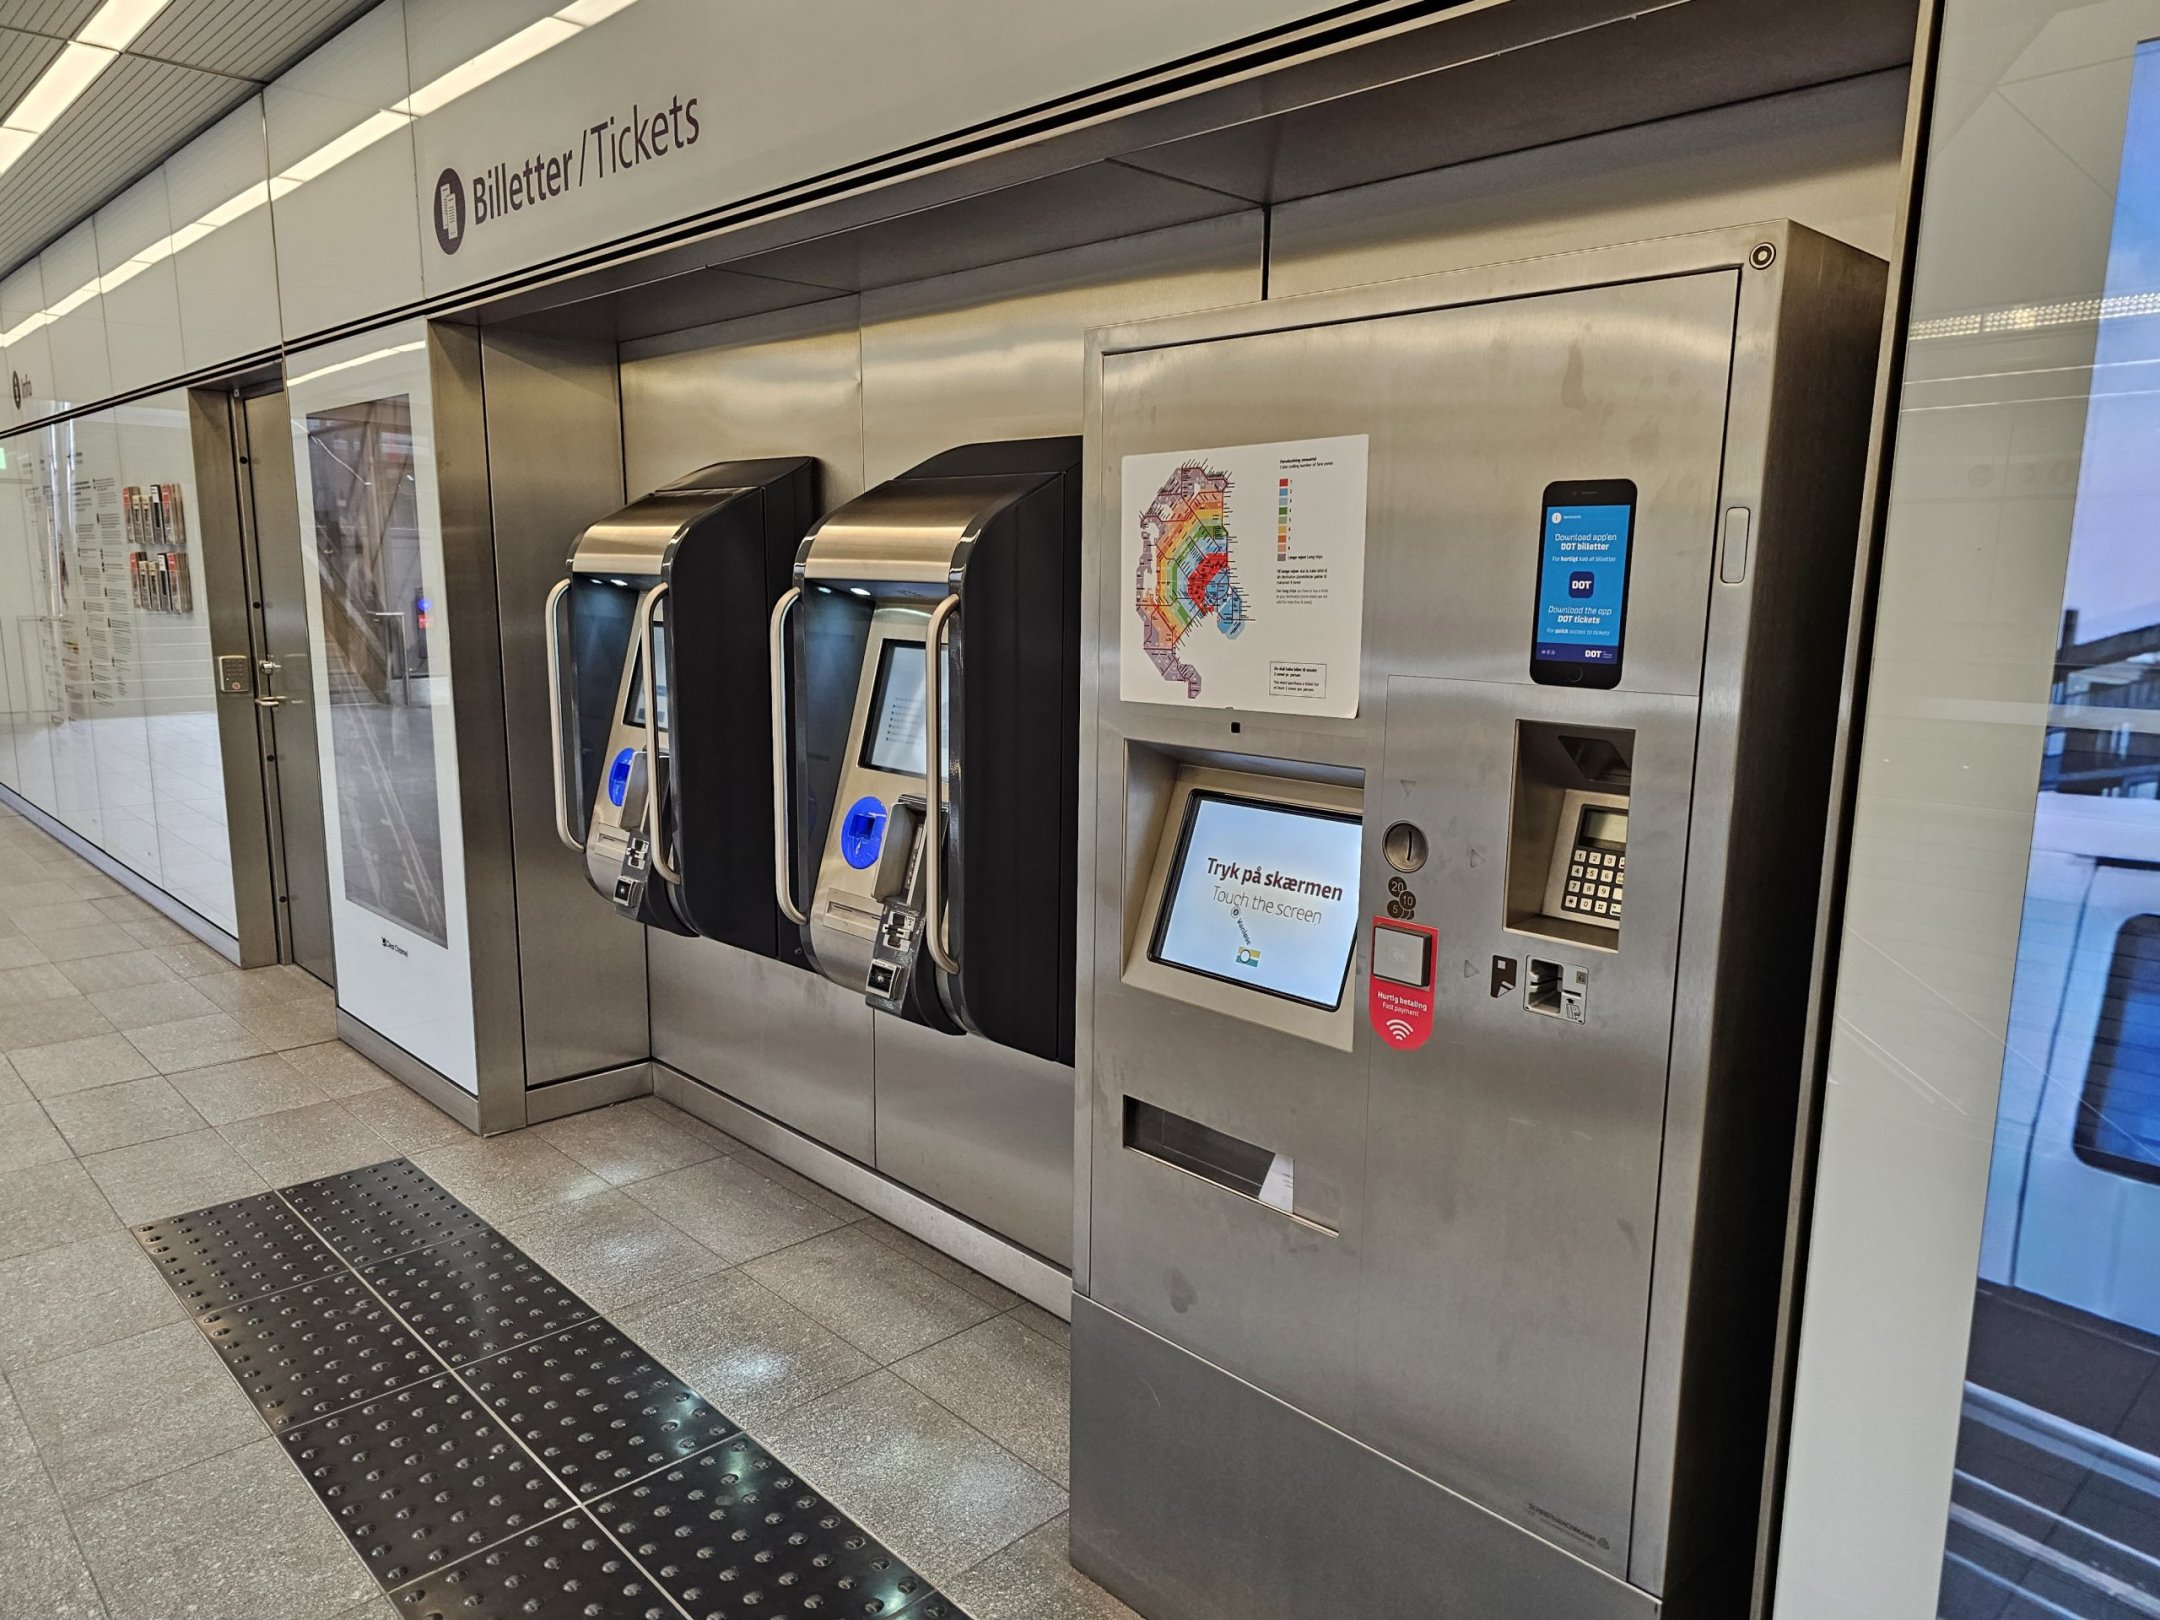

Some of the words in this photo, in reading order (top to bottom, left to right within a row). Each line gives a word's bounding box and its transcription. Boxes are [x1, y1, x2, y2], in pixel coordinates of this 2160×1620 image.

[473, 149, 573, 226] Billetter
[590, 94, 700, 179] Tickets
[1555, 533, 1592, 542] Download
[1572, 580, 1592, 590] DOT
[1548, 606, 1583, 614] Download
[1598, 608, 1612, 616] app
[1574, 616, 1600, 624] tickets
[1584, 650, 1602, 658] DOT
[1208, 857, 1240, 881] Tryk
[1240, 866, 1262, 886] på
[1264, 870, 1343, 901] skærmen
[1392, 881, 1404, 892] 20
[1212, 885, 1250, 908] Touch
[1252, 895, 1274, 914] the
[1275, 903, 1322, 924] screen
[1402, 896, 1414, 906] 10
[1392, 904, 1398, 914] 5
[1377, 991, 1399, 1004] Hurtig
[1400, 998, 1428, 1012] betaling
[1382, 1002, 1394, 1010] Fast
[1394, 1005, 1420, 1018] payment
